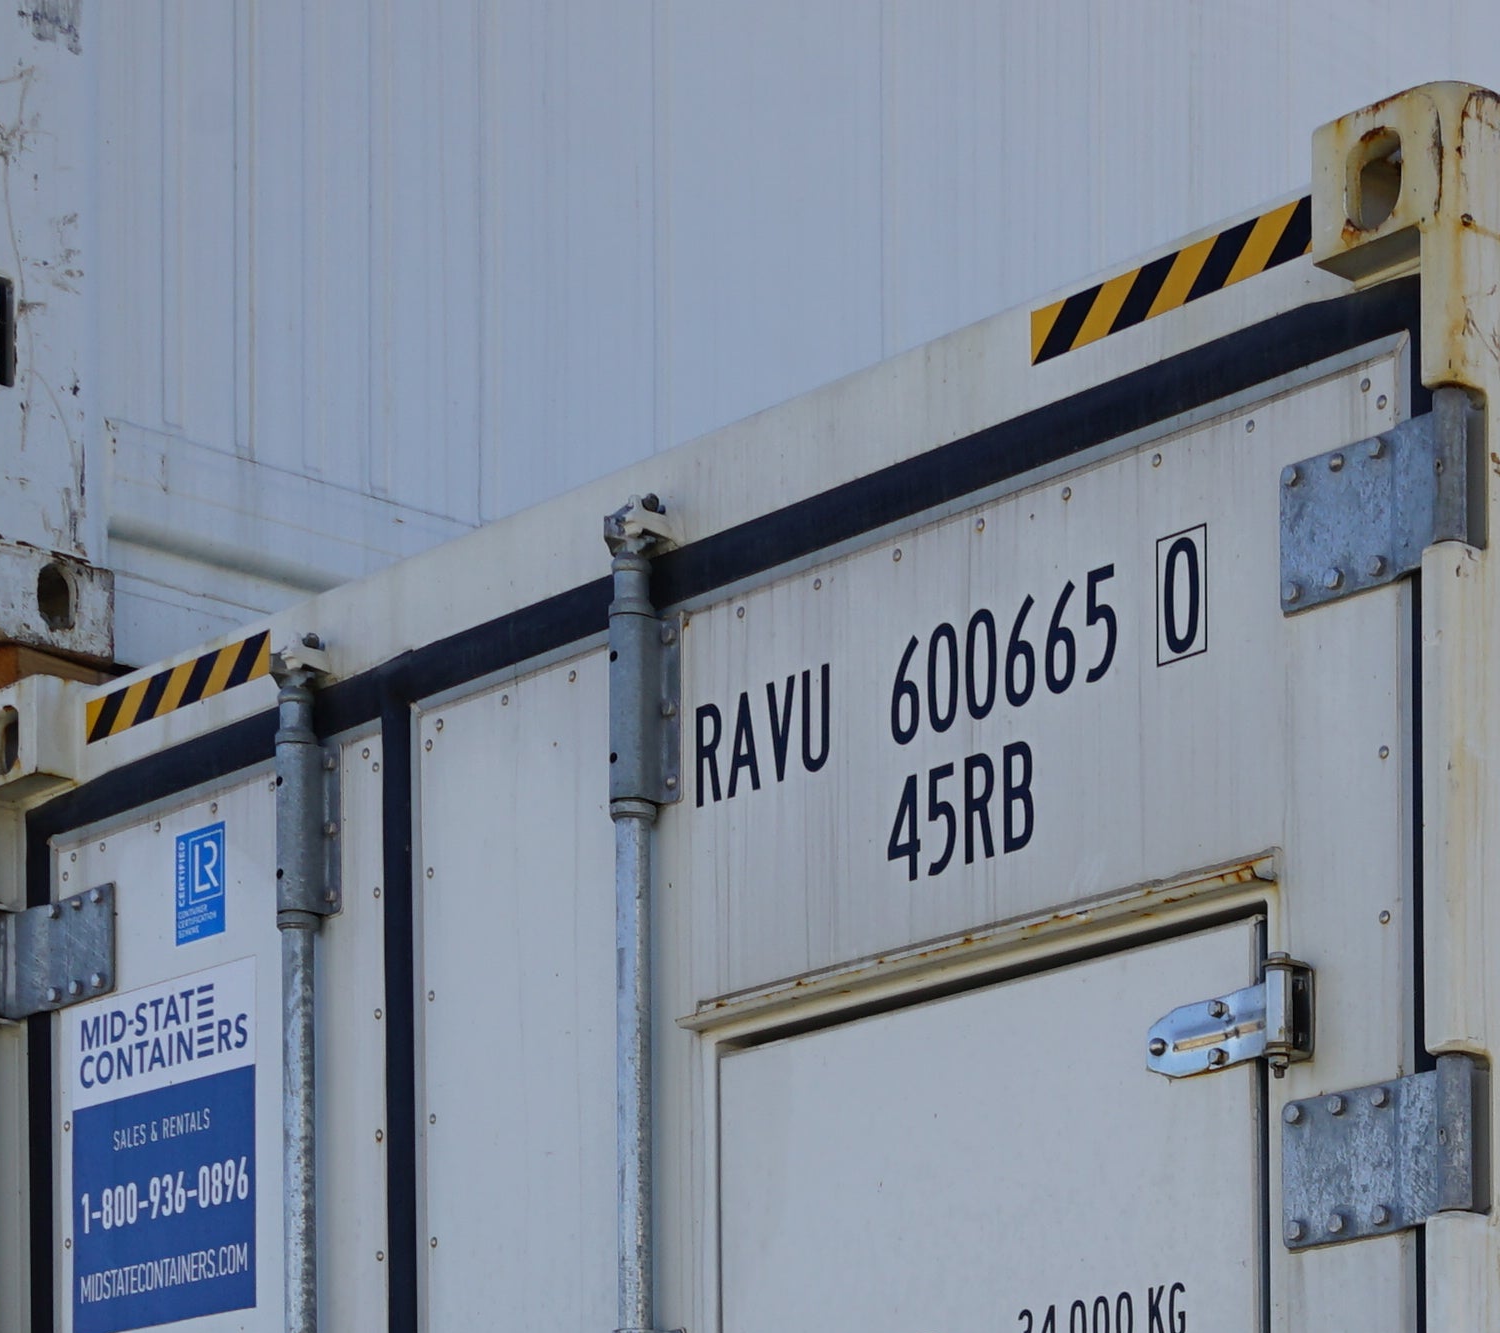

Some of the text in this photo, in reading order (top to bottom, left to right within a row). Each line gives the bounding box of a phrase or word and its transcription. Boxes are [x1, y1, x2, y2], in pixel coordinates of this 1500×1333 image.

[696, 663, 831, 809] RAVU
[890, 563, 1118, 746] 600665
[887, 740, 1035, 882] 45RB
[178, 841, 186, 907] CERTIFIED
[80, 983, 215, 1052] MID-STATE
[80, 1012, 248, 1089] CONTAINERS
[113, 1108, 211, 1151] SALES & RENTALS
[81, 1156, 249, 1234] 1-800-936-0896
[80, 1242, 248, 1304] MIDSTATECONTAINERS.COM
